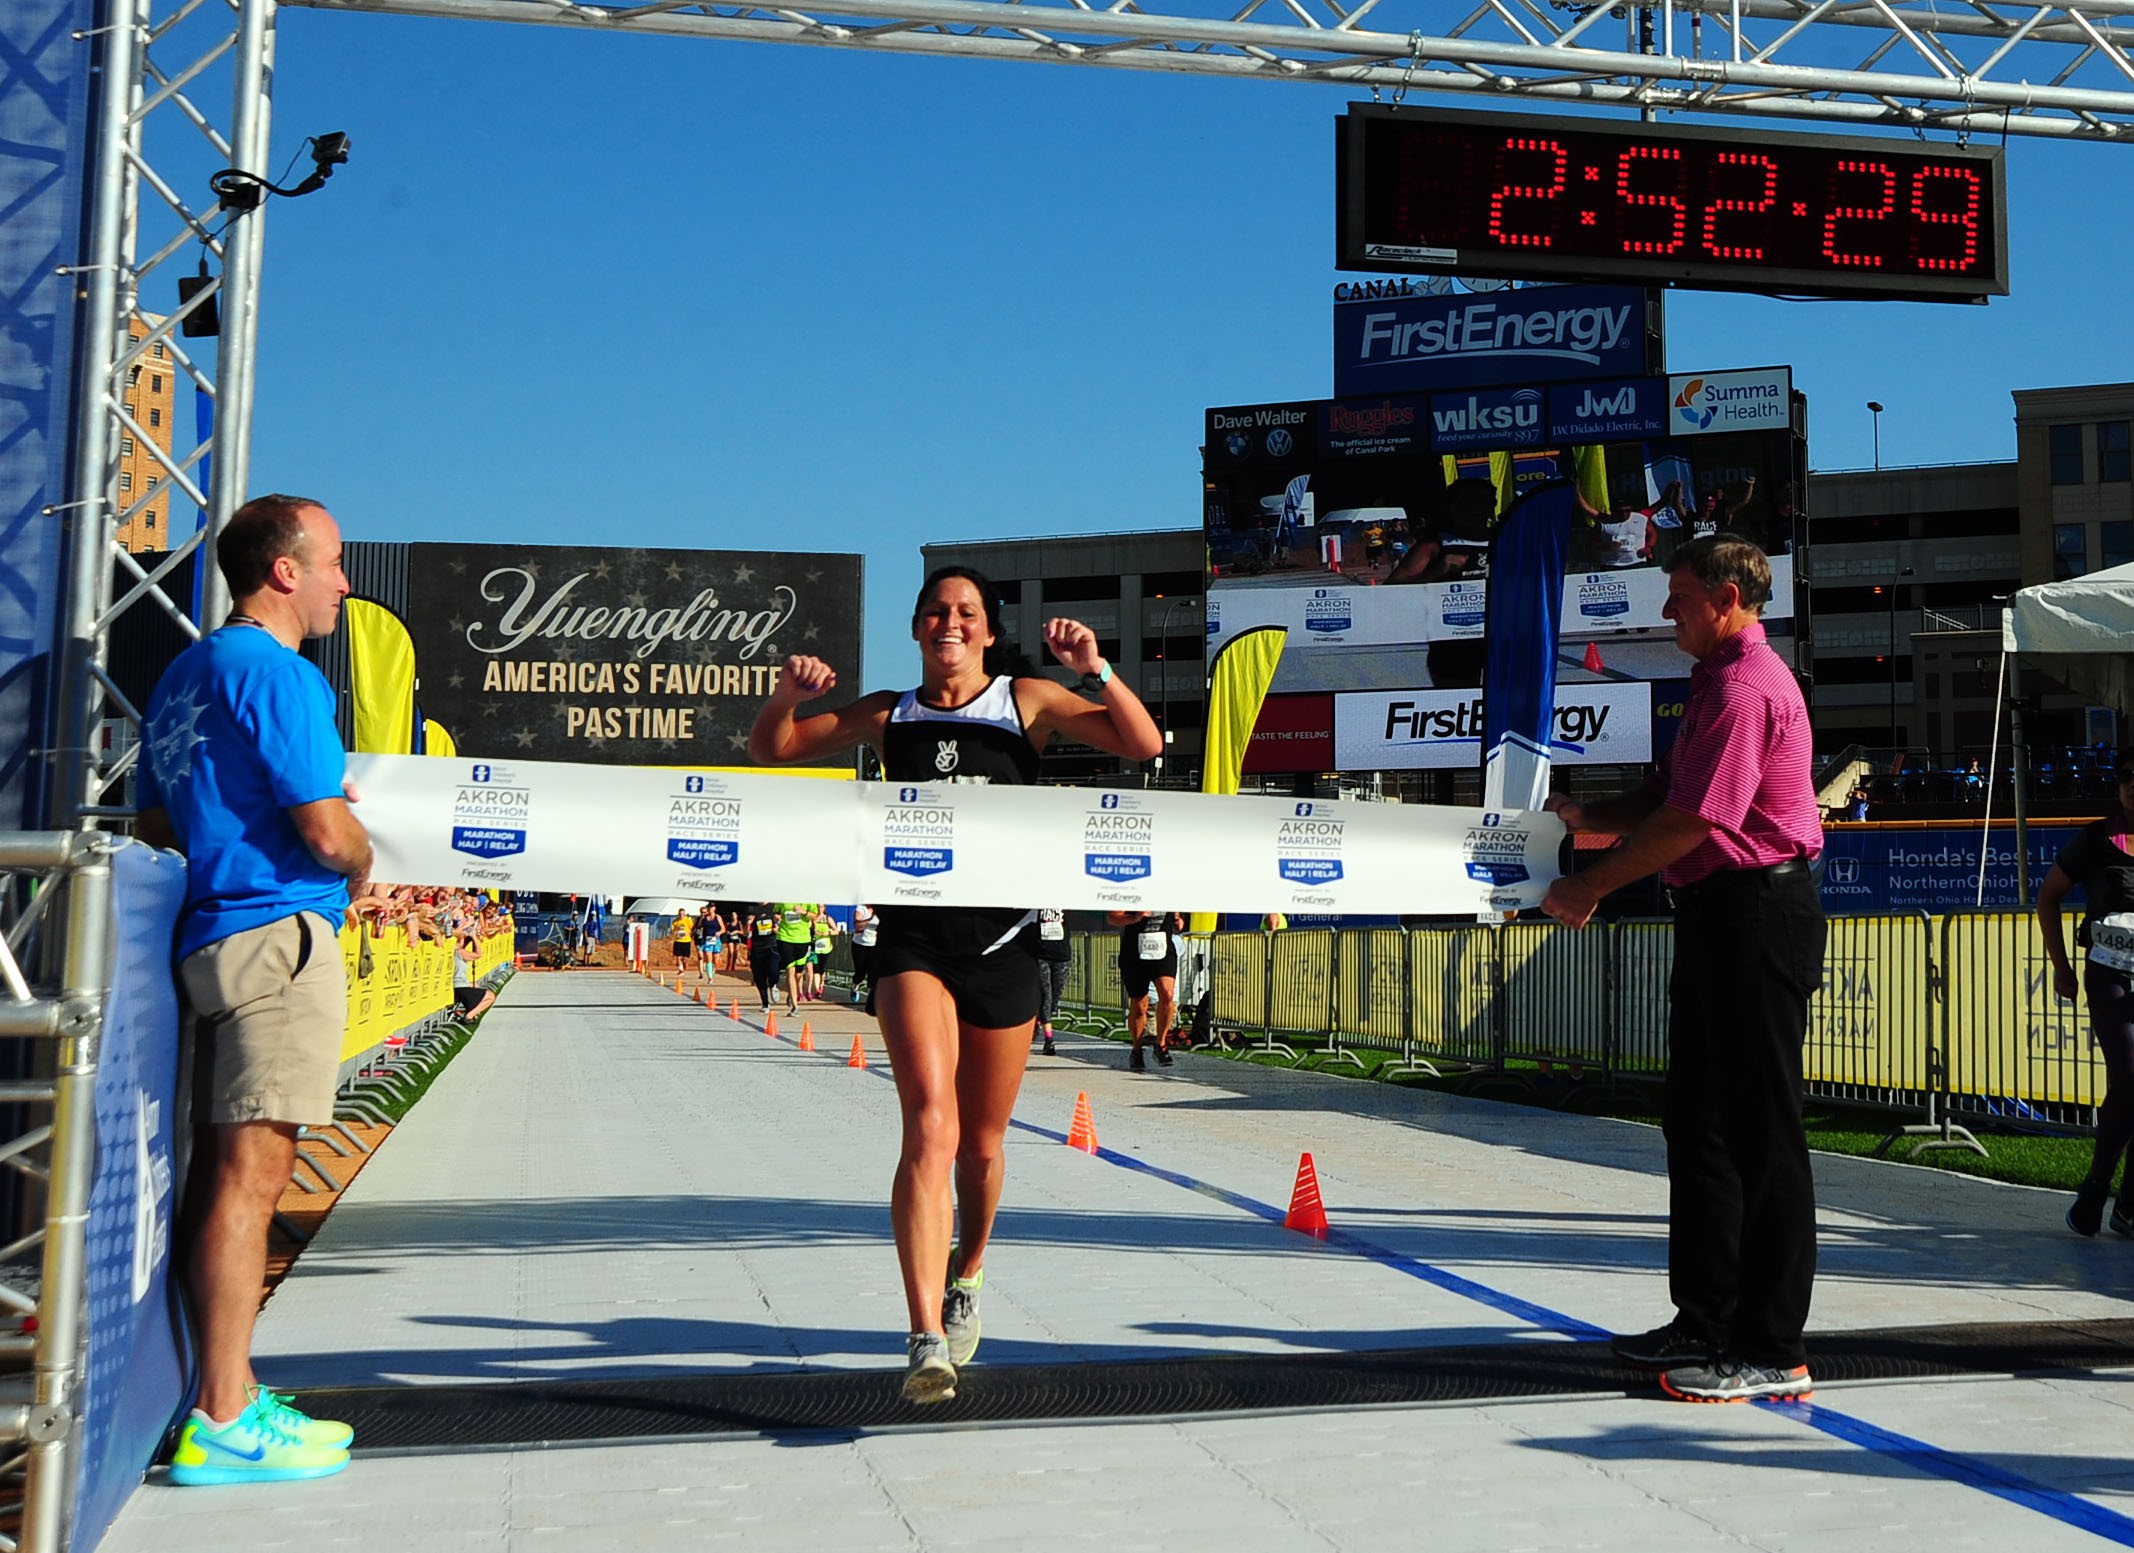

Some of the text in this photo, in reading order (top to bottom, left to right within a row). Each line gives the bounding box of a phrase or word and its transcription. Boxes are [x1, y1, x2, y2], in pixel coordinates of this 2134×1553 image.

[1334, 278, 1414, 301] CANAL
[1360, 304, 1631, 358] FirstEnergy
[1705, 384, 1779, 401] Summa
[1432, 396, 1538, 433] wksu
[1724, 402, 1778, 420] Health
[1213, 409, 1307, 430] Dave Walter
[1328, 399, 1416, 436] Ruggles
[1570, 422, 1604, 434] Didado
[1330, 436, 1411, 448] The official ice cream
[1355, 446, 1376, 454] Canal
[1378, 445, 1396, 453] Park
[1579, 584, 1627, 593] AKRON
[466, 567, 797, 660] Yuengling
[482, 660, 641, 694] AMERICA'S
[566, 706, 695, 739] PASTIME
[1252, 730, 1329, 740] TASTE THE FEELING
[456, 789, 529, 805] AKRON
[454, 804, 528, 816] MARATHON
[670, 800, 741, 816] AKRON
[668, 815, 740, 828] MARATHON
[886, 809, 953, 824] AKRON
[1086, 815, 1153, 830] AKRON
[884, 824, 953, 835] MARATHON
[1279, 822, 1344, 835] AKRON
[463, 830, 515, 841] MARATHON
[1085, 831, 1151, 841] MARATHON
[1278, 836, 1342, 846] MARATHON
[1465, 831, 1529, 843] AKRON
[457, 840, 519, 850] HALF RELAY
[678, 841, 728, 852] MARATHON
[1463, 842, 1525, 852] MARATHON
[673, 850, 732, 861] HALF RELAY
[894, 850, 943, 860] MARATHON
[1094, 857, 1142, 865] MARATHON
[1889, 847, 1976, 867] Honda's
[890, 859, 947, 869] HALF RELAY
[1288, 861, 1334, 870] MARATHON
[1090, 866, 1146, 875] HALF RELAY
[1284, 870, 1339, 878] HALF RELAY
[1889, 896, 1932, 904] Northern
[1938, 896, 1960, 904] Ohio
